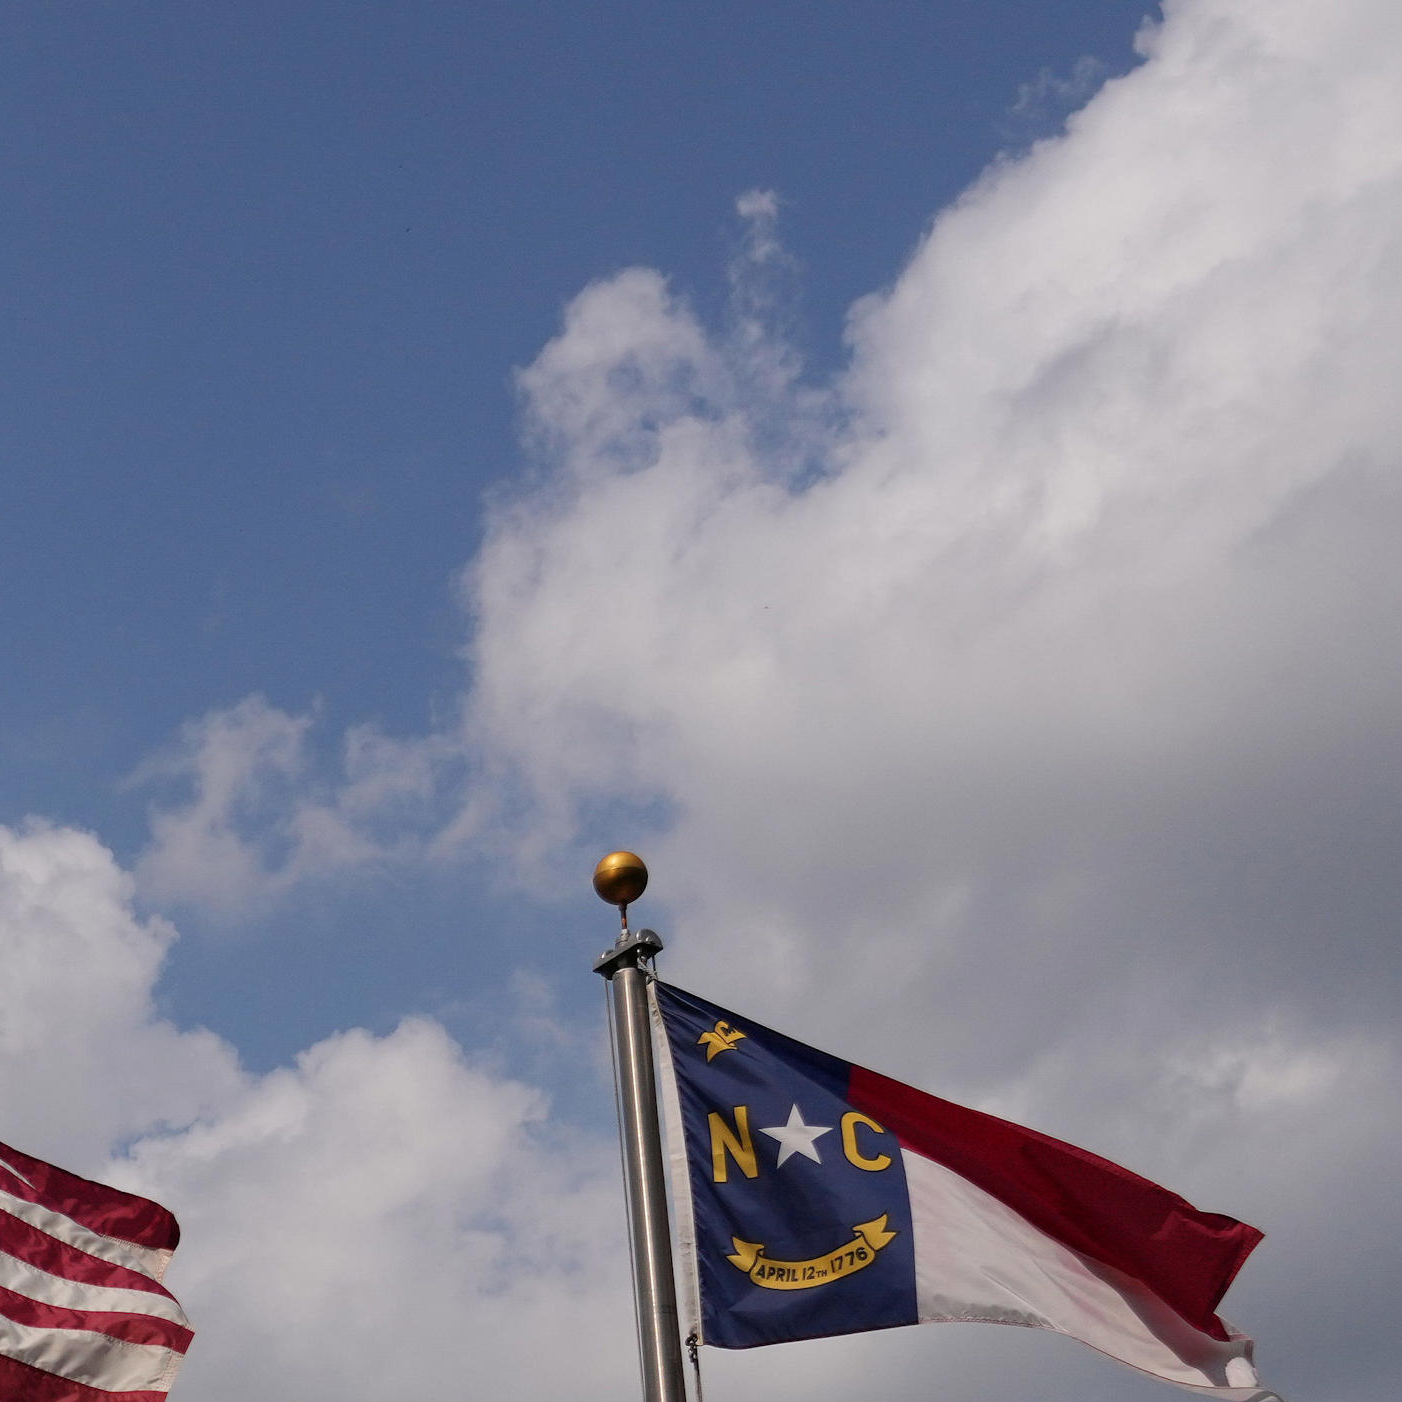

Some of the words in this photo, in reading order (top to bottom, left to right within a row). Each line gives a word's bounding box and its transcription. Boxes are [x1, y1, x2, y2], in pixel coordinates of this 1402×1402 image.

[707, 1105, 759, 1184] N
[840, 1111, 893, 1172] C
[755, 1264, 799, 1283] APRIL
[802, 1265, 828, 1281] 12TH
[830, 1246, 869, 1274] 1776
